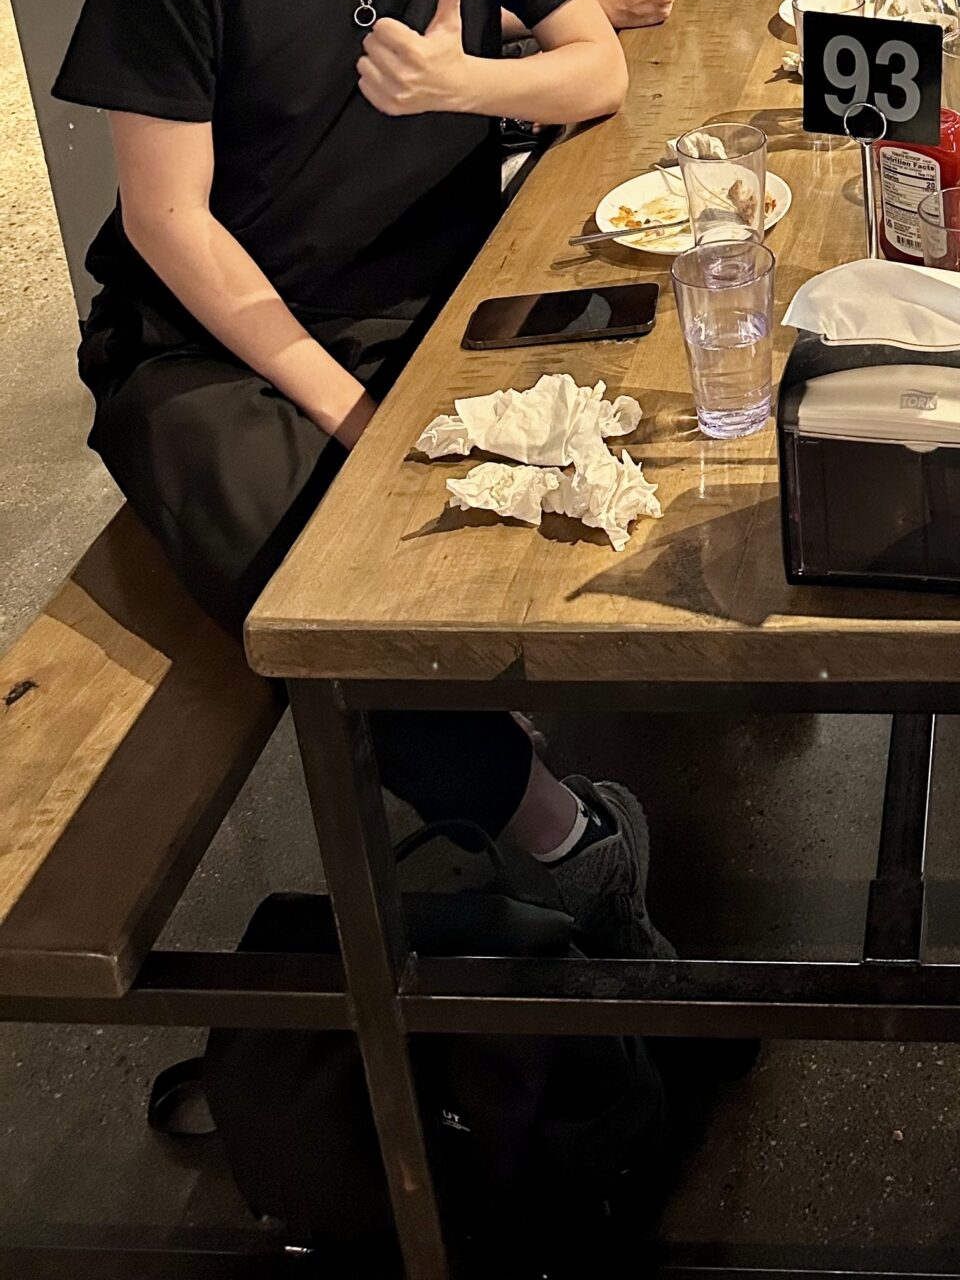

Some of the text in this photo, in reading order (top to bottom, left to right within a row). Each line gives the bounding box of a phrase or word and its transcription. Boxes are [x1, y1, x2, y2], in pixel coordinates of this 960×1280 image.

[823, 34, 921, 122] 93
[882, 153, 911, 167] Nutrition
[913, 162, 935, 171] Facts
[926, 181, 936, 189] 20
[902, 396, 937, 409] TORK
